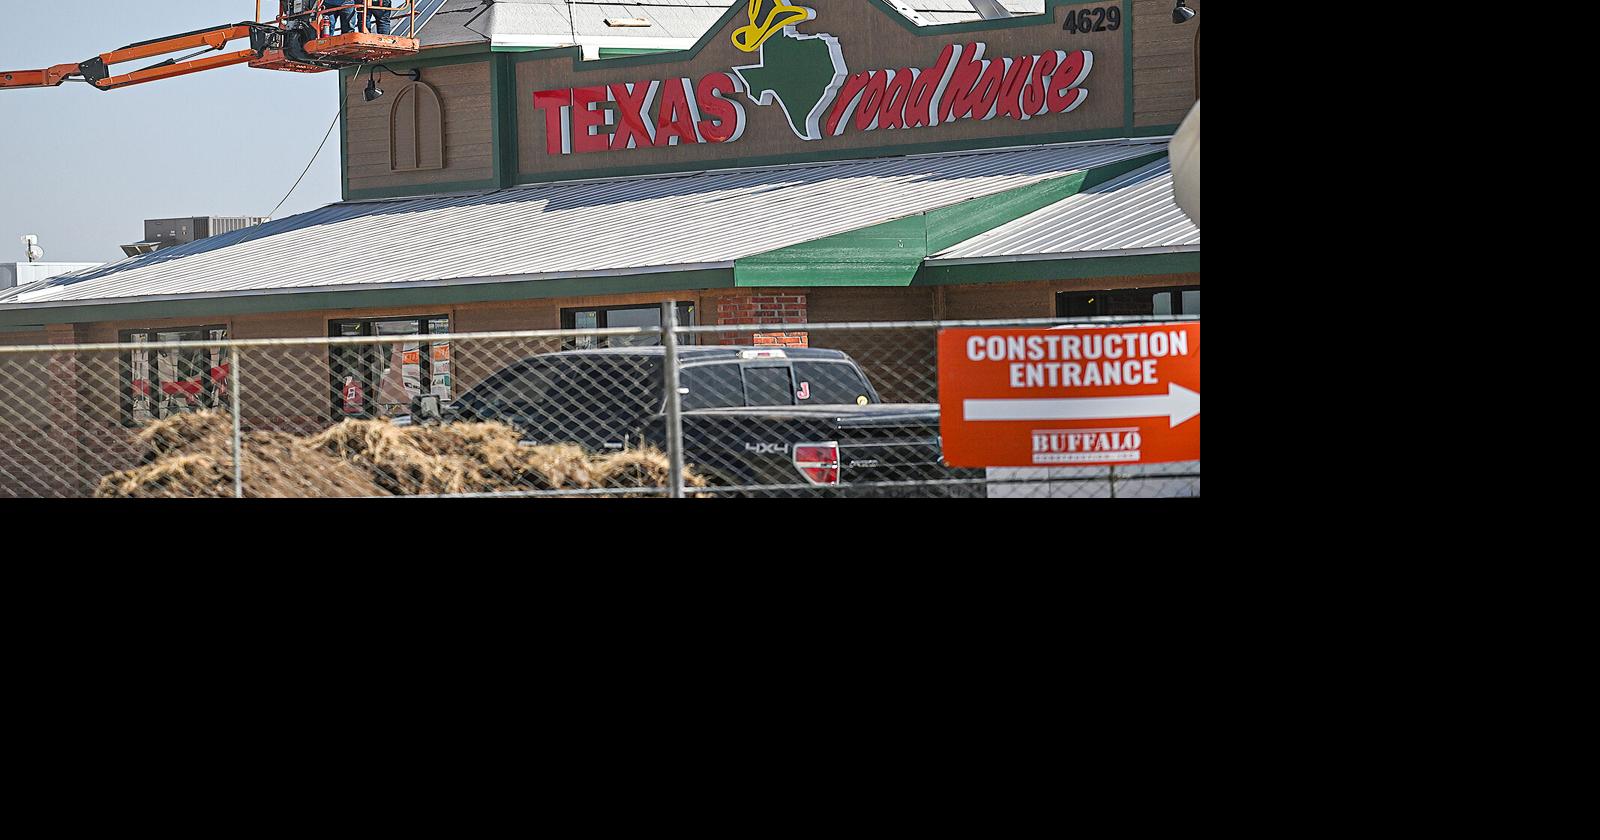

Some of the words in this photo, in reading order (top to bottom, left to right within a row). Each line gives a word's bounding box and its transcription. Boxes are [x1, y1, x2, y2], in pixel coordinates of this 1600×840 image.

[1062, 5, 1121, 35] 4629
[533, 71, 743, 155] TEXAS
[826, 42, 1093, 137] roadhouse
[966, 330, 1188, 361] CONSTRUCTION
[1010, 359, 1158, 388] ENTRANCE
[1032, 431, 1142, 453] BUFFALO
